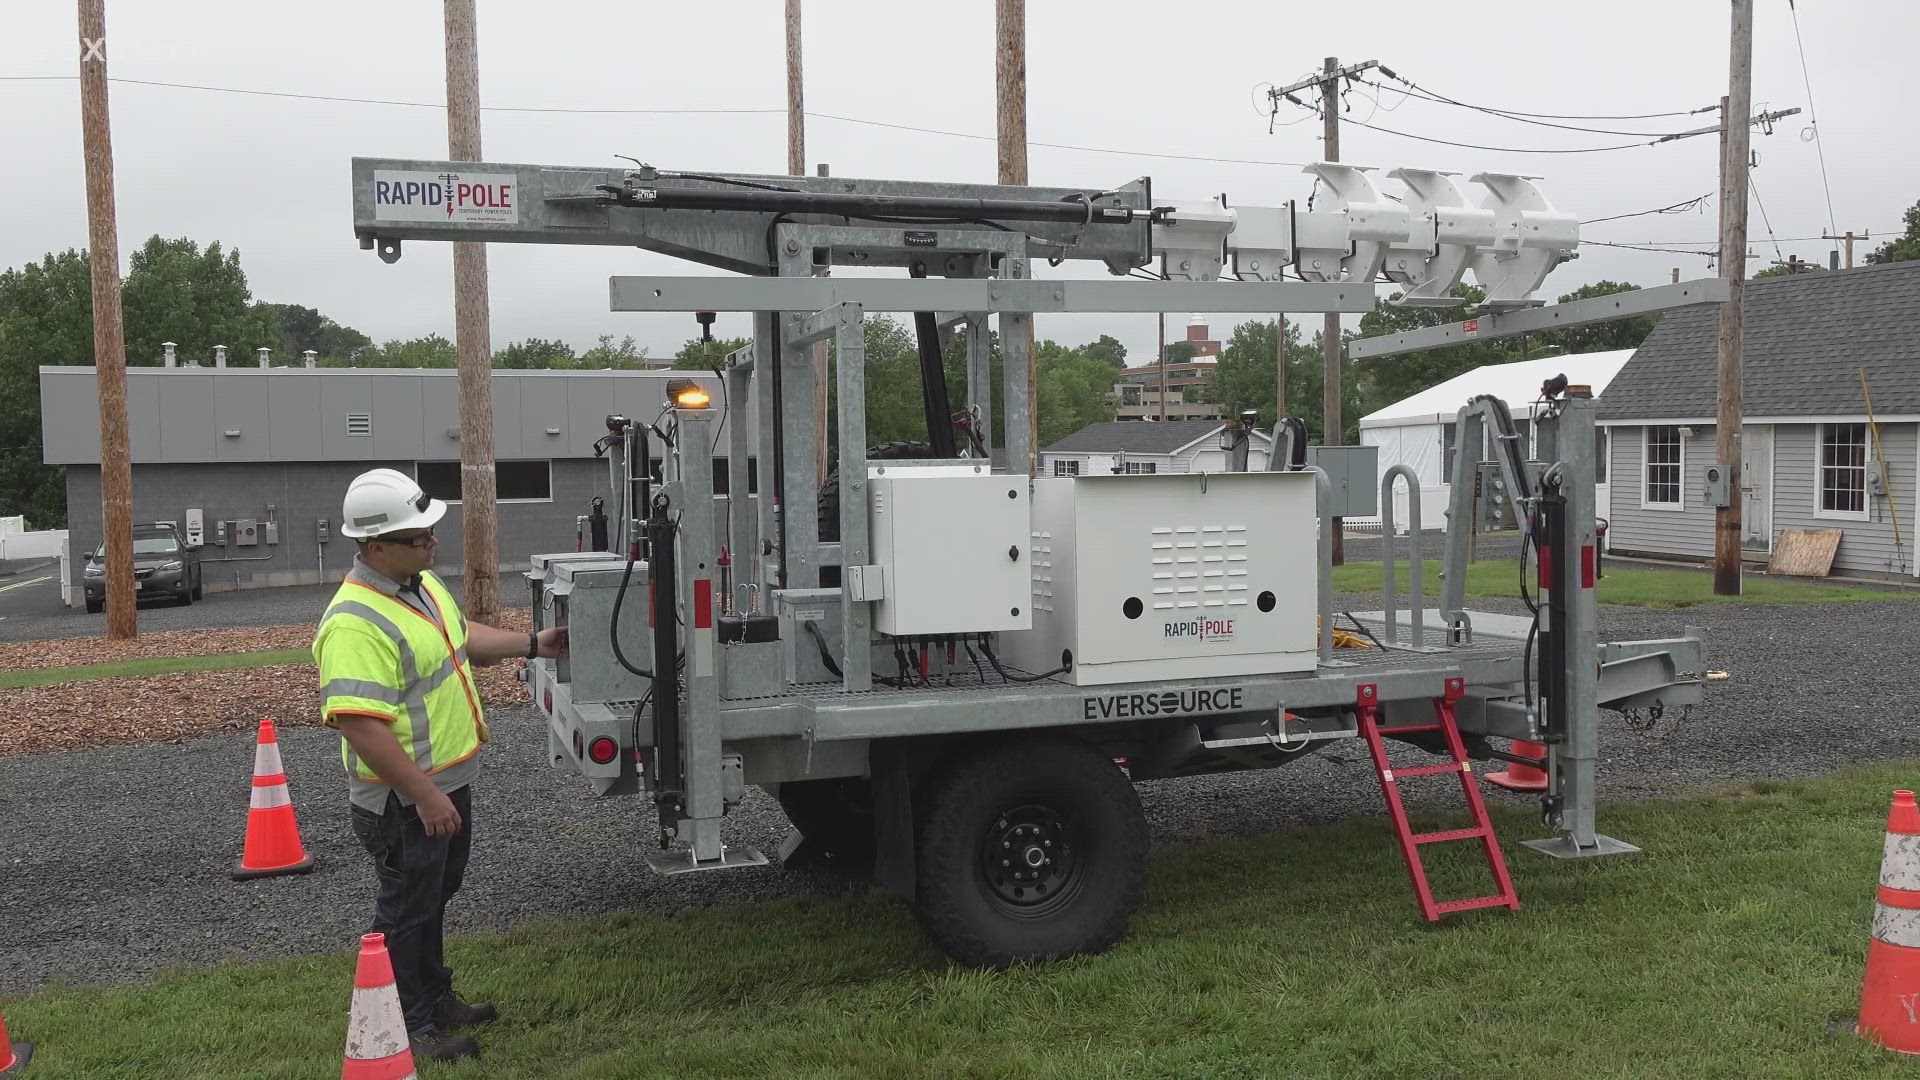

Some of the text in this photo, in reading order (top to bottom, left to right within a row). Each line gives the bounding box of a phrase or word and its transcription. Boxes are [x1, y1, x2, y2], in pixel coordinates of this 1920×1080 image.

[376, 181, 512, 208] RAPID POLE
[1164, 619, 1233, 637] RAPID POLE
[1084, 688, 1243, 720] EVERSOURCE
